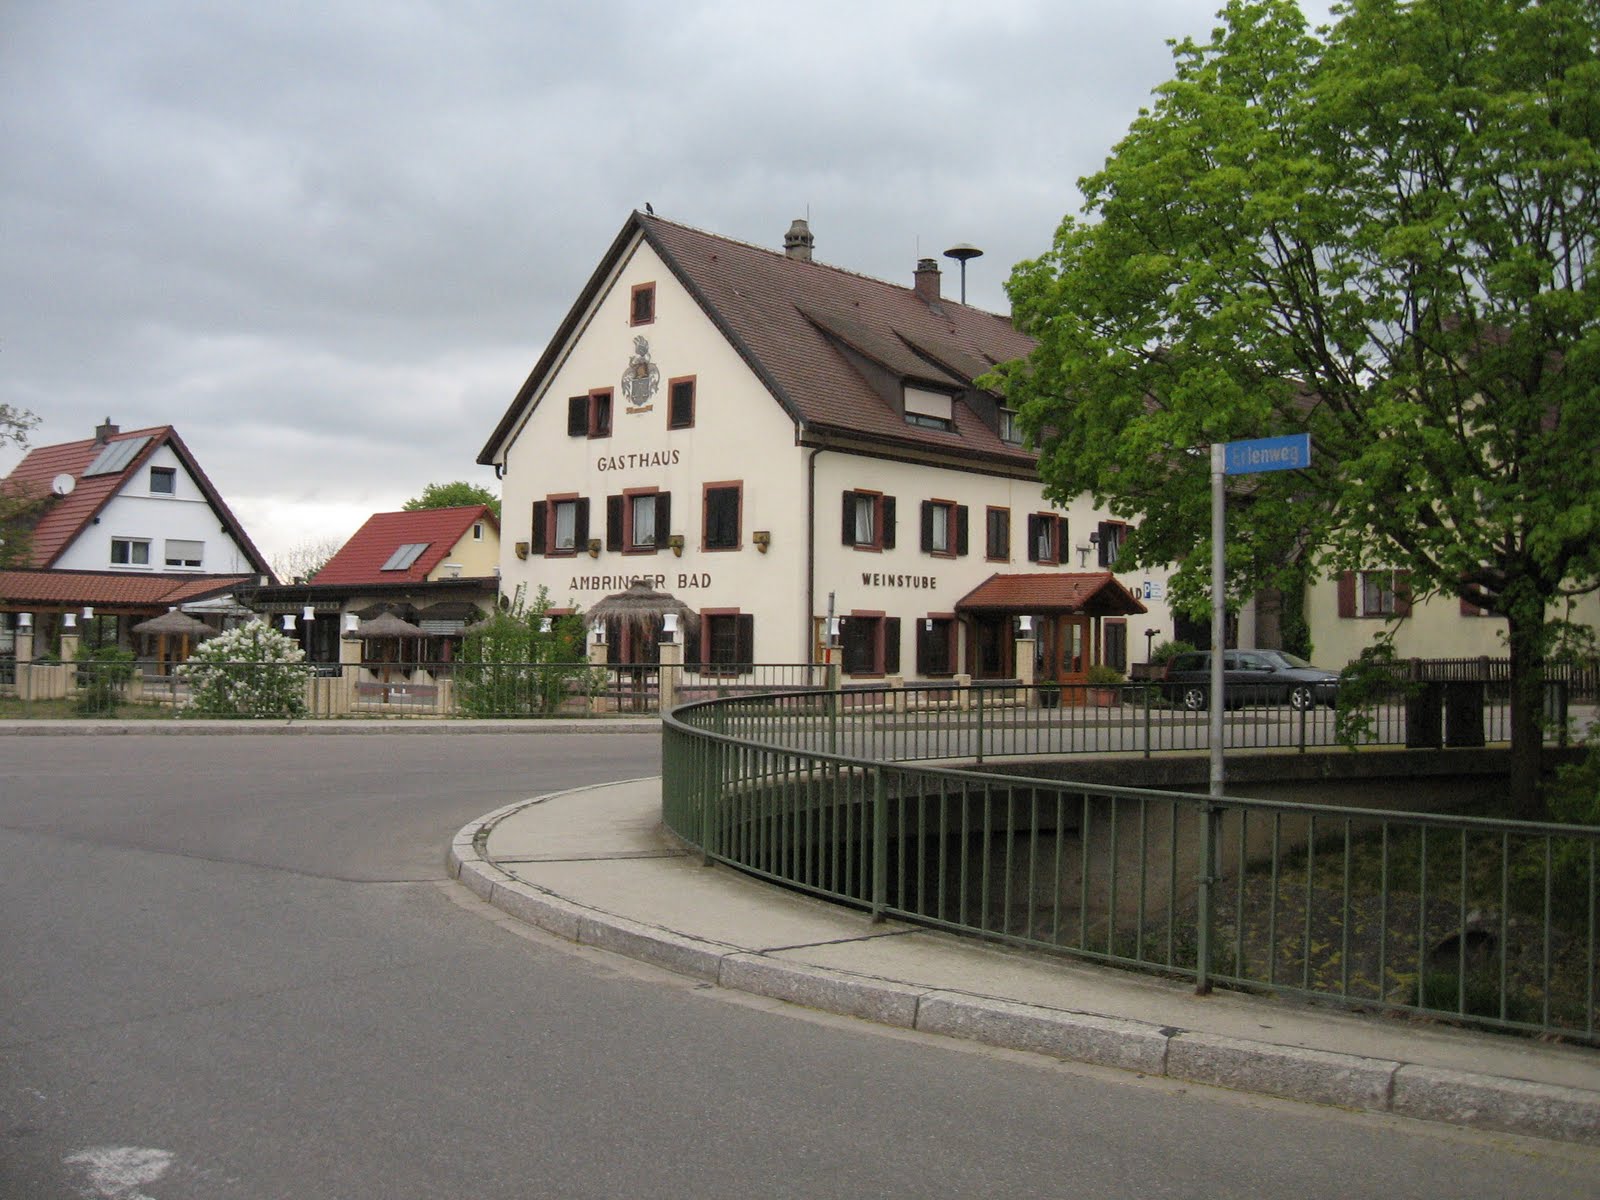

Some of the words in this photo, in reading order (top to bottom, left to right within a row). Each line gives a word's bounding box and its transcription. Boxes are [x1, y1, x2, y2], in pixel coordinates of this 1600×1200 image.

[597, 449, 680, 472] GASTHAUS
[677, 573, 712, 589] BAD
[862, 573, 937, 589] WEINSTUBE
